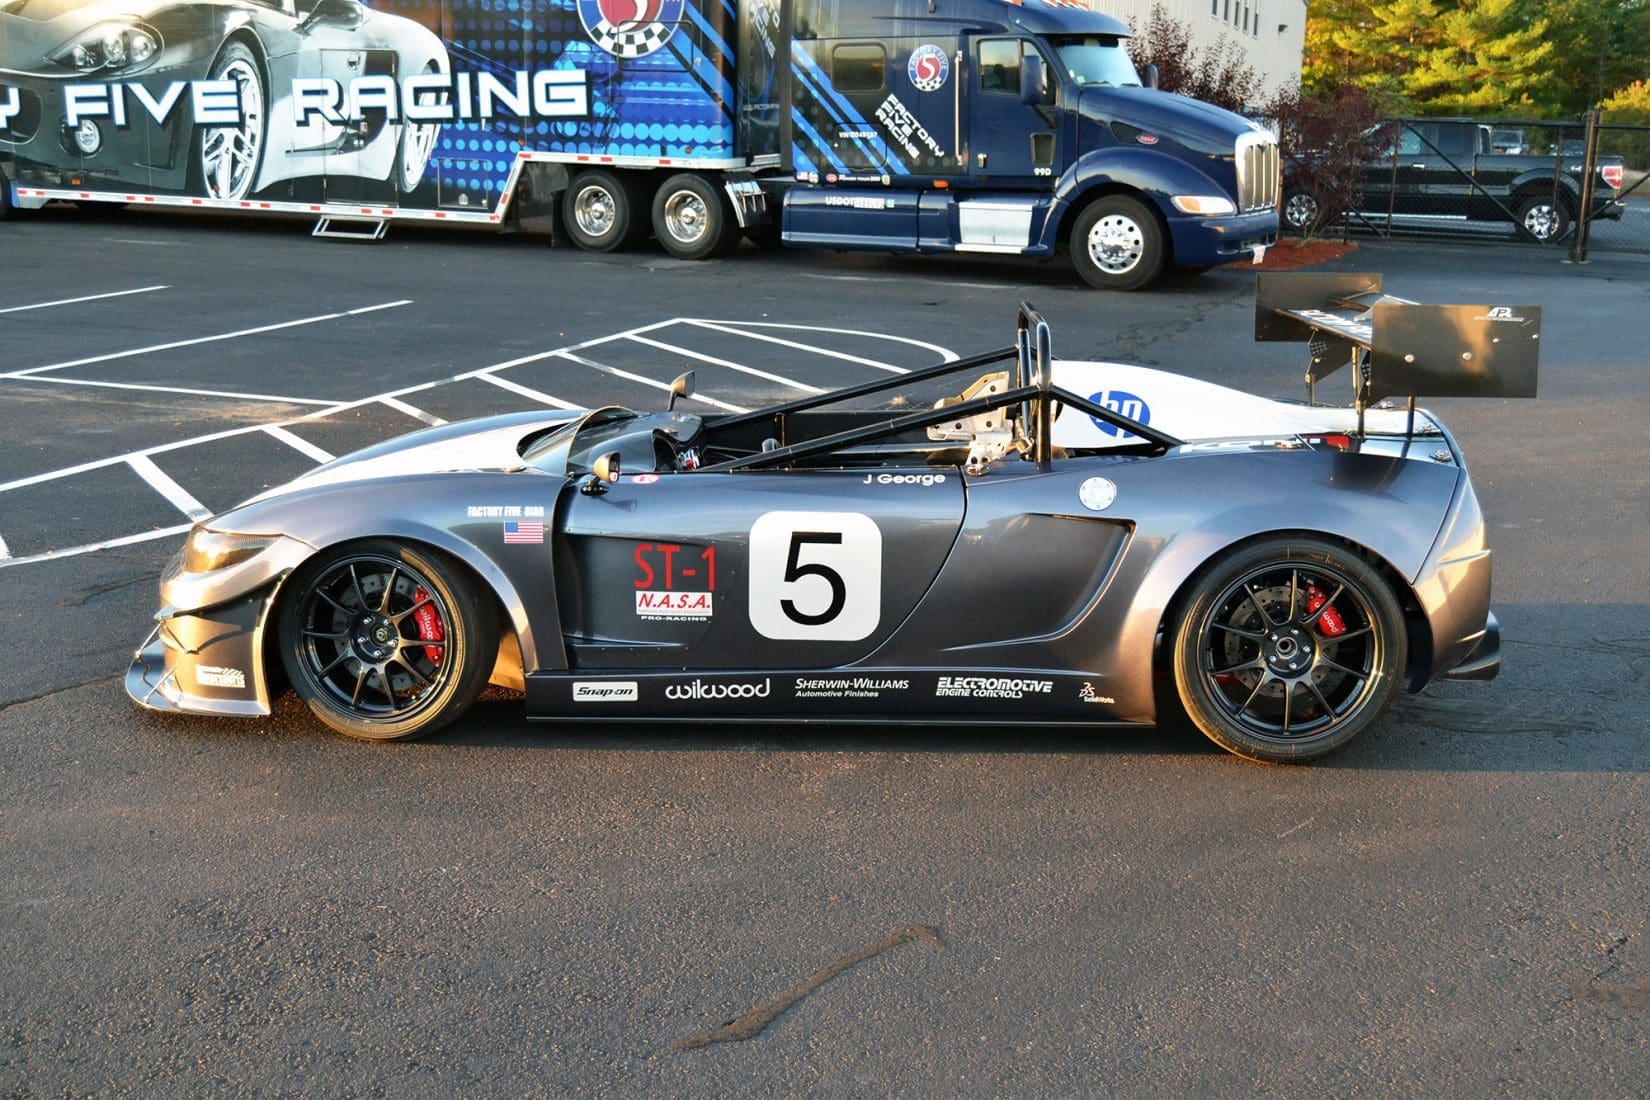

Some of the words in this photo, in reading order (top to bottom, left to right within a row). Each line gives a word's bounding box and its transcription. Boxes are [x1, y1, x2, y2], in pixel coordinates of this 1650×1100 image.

[64, 79, 240, 128] FIVE
[293, 68, 589, 127] RACING
[881, 101, 914, 137] FIVE
[886, 93, 945, 157] FACTORY
[875, 108, 920, 159] RACING
[863, 474, 873, 484] J
[877, 472, 946, 487] George
[467, 506, 503, 518] FACTORY
[504, 506, 522, 518] FIVE
[633, 543, 716, 591] ST-1
[779, 531, 847, 626] 5
[638, 593, 711, 609] N.A.S.A.
[576, 686, 634, 698] Snap-on
[665, 678, 771, 700] wilwood
[795, 678, 909, 690] SHERWIN-WILLIAMS
[937, 676, 1054, 693] ELECTROMOTIVE
[795, 690, 843, 698] Automotive
[844, 690, 879, 698] Finishes
[935, 688, 971, 697] ENGINE
[972, 689, 1023, 699] CONTROLS
